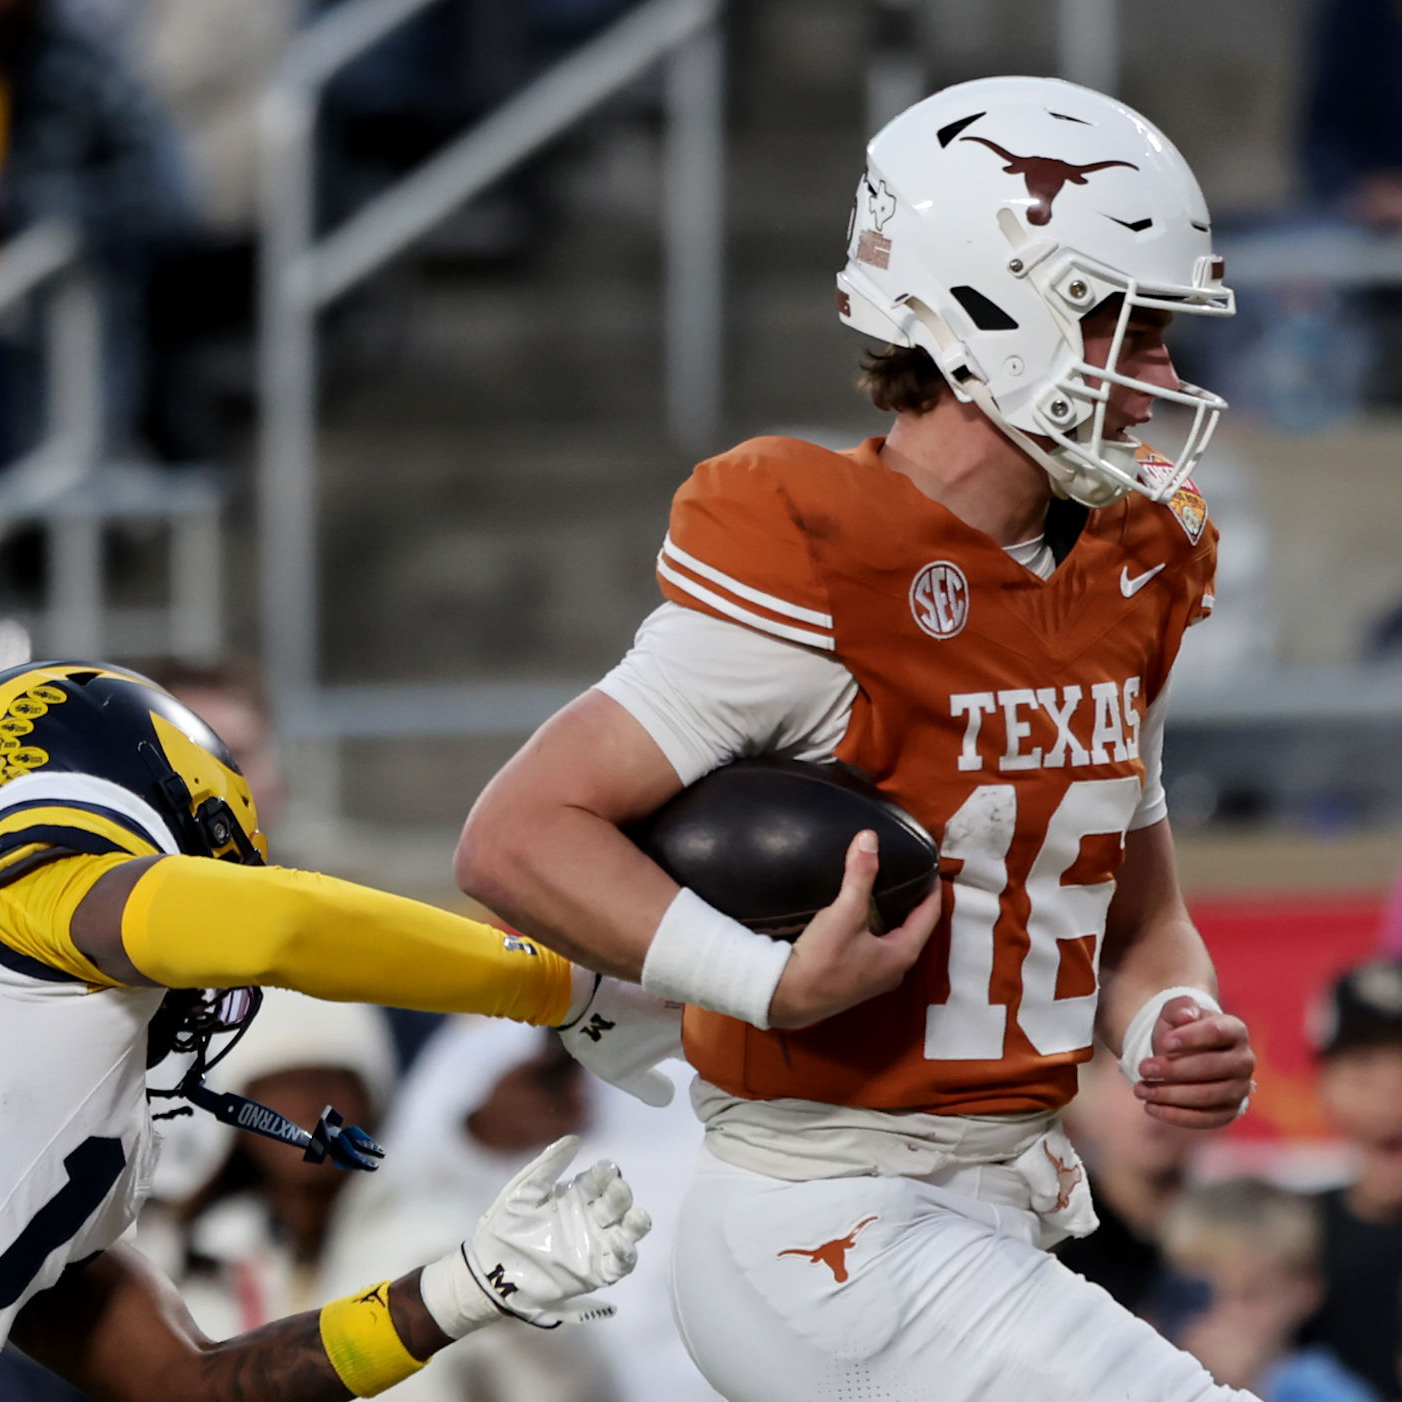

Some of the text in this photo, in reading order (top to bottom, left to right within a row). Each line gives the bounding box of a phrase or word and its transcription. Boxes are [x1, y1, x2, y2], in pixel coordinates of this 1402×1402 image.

[914, 565, 965, 634] SEC
[950, 676, 1141, 772] TEXAS
[923, 775, 1142, 1061] 16
[237, 1102, 302, 1142] NXTRND
[486, 1262, 519, 1300] M
